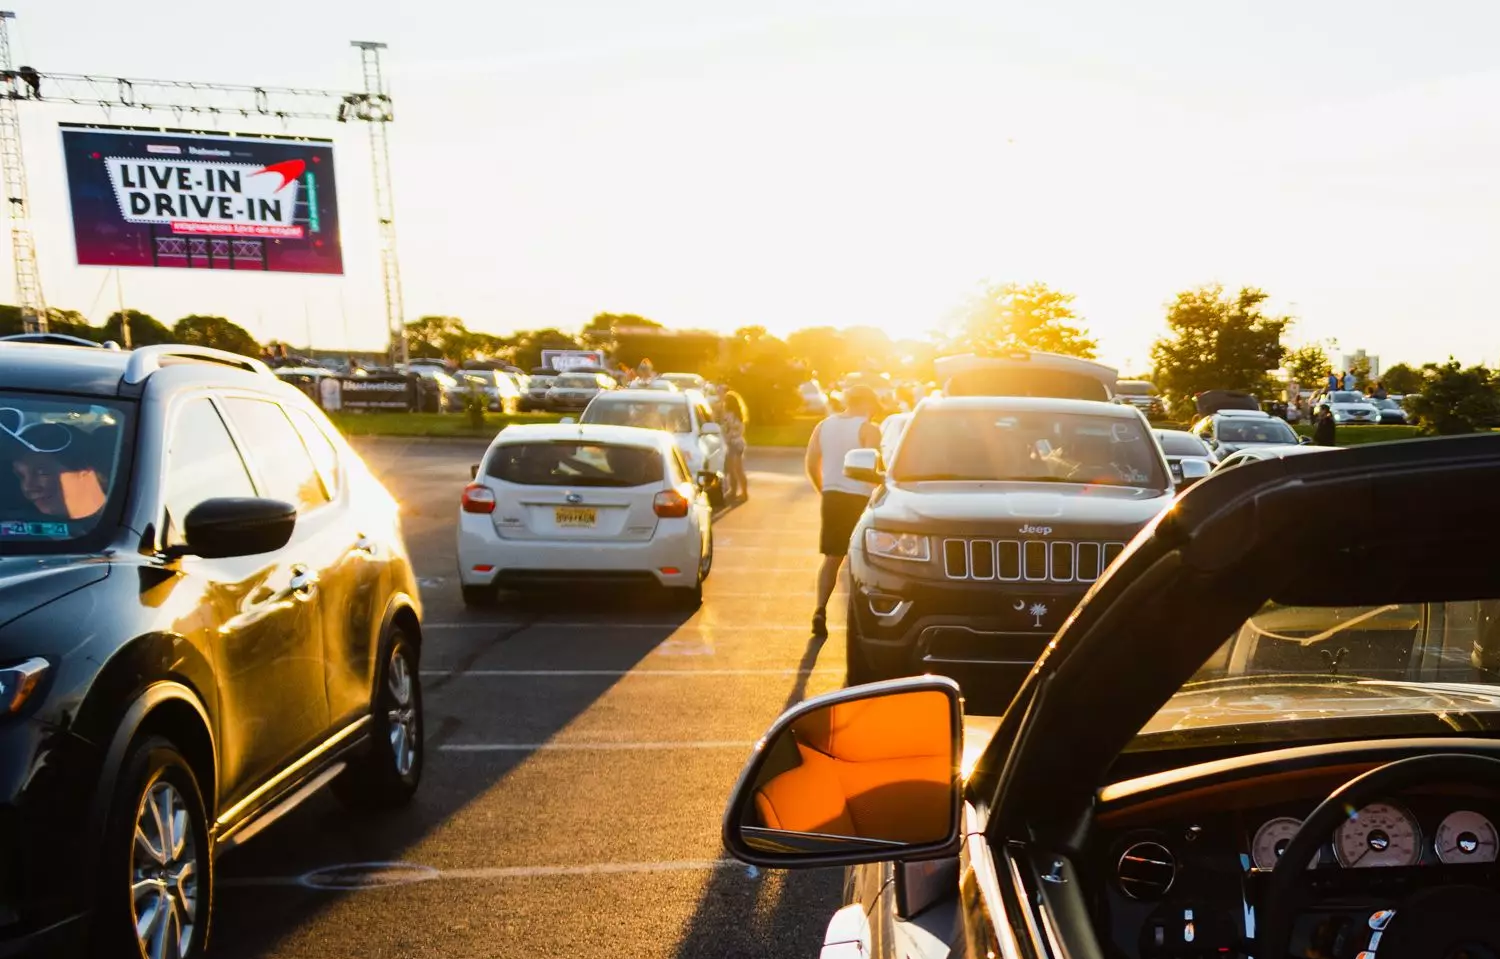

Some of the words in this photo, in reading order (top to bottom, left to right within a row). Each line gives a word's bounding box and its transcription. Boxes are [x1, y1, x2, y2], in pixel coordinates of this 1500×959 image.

[120, 164, 242, 193] LIVE-IN
[129, 191, 282, 222] DRIVE-IN
[1019, 524, 1052, 536] Jeep
